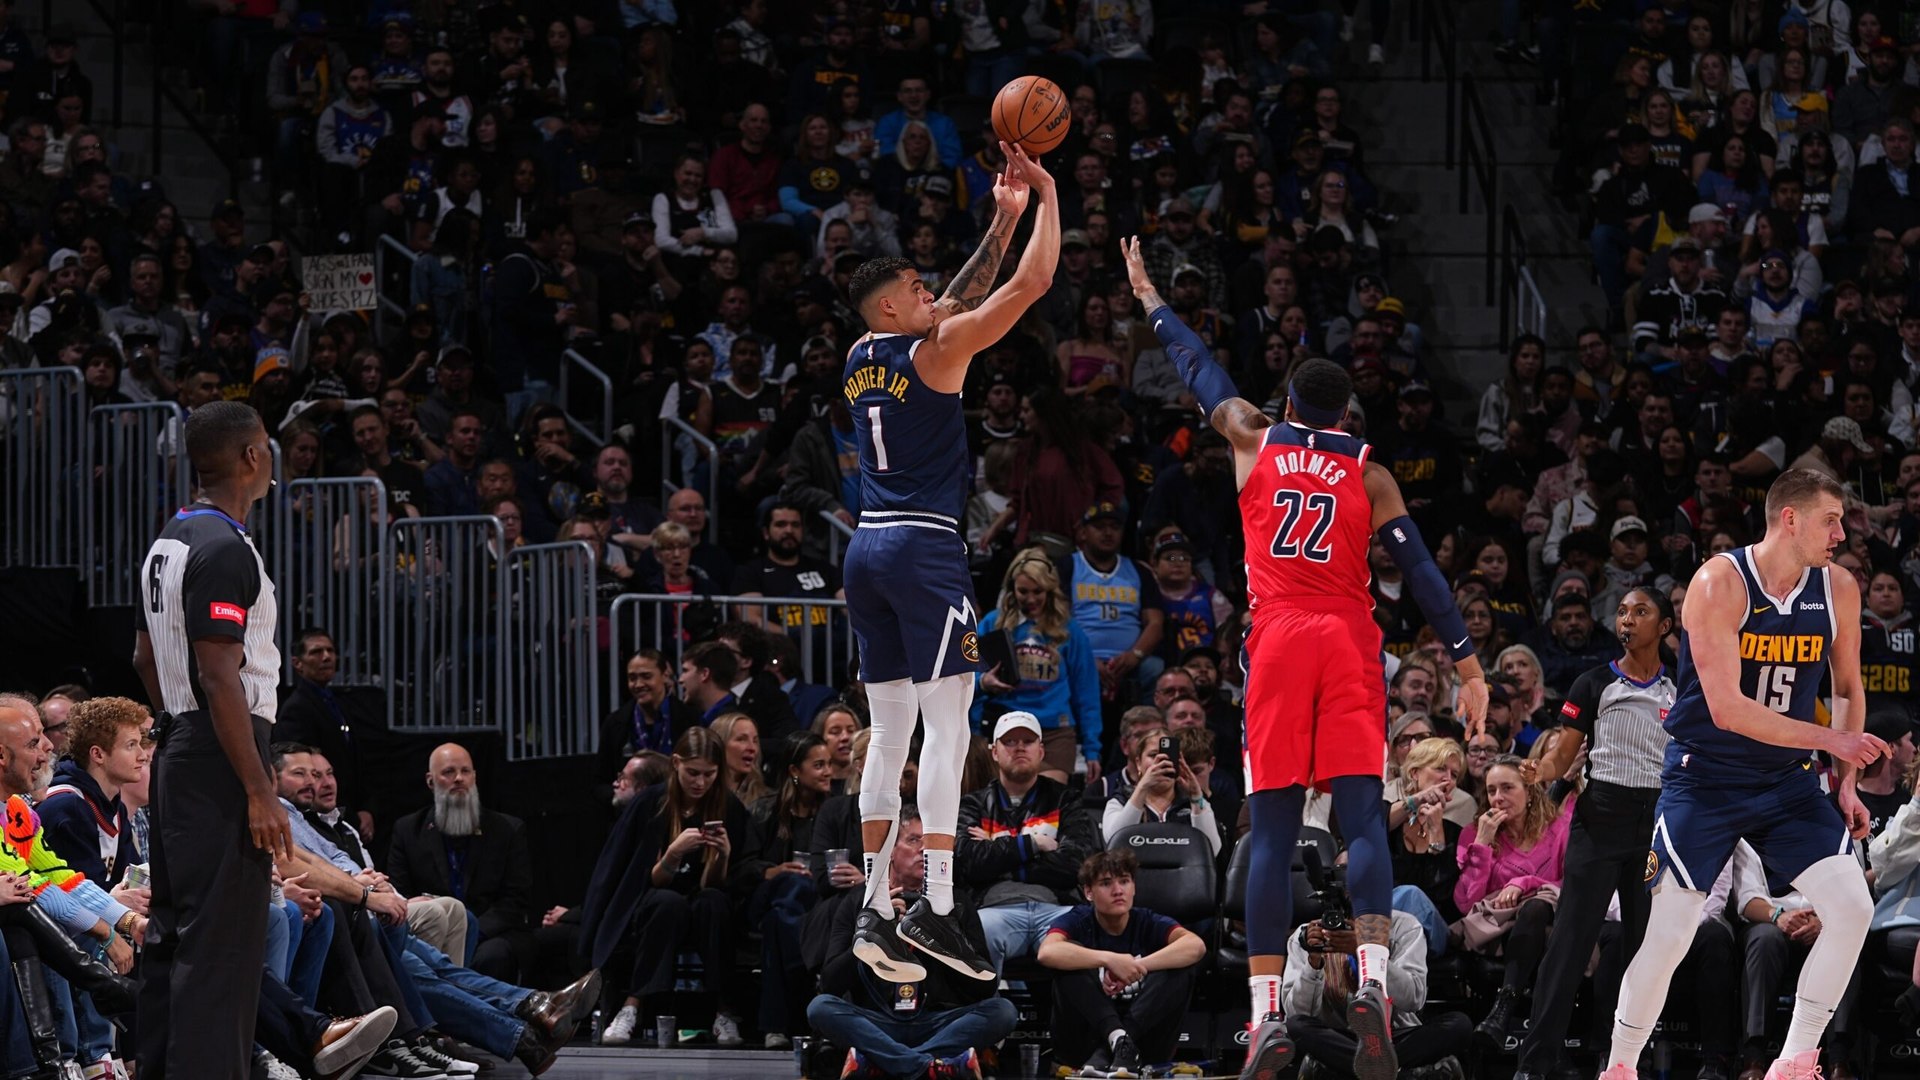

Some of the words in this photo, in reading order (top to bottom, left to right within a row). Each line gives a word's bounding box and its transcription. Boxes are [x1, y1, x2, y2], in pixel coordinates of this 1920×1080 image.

[304, 273, 334, 290] SIGN
[340, 271, 360, 289] MY
[310, 291, 350, 309] SHOES
[350, 288, 376, 307] PLZ
[843, 365, 886, 406] PORTER
[887, 371, 910, 403] JR.
[868, 406, 888, 470] 1
[1274, 450, 1347, 486] HOLMES
[1270, 488, 1337, 564] 22
[796, 570, 826, 591] 50
[1076, 583, 1137, 603] DENVER
[1101, 603, 1119, 620] 15
[1799, 601, 1825, 611] ibotta
[1739, 631, 1825, 663] DENVER
[1891, 631, 1915, 655] 50
[1755, 665, 1797, 713] 15
[1145, 837, 1190, 845] LEXUS
